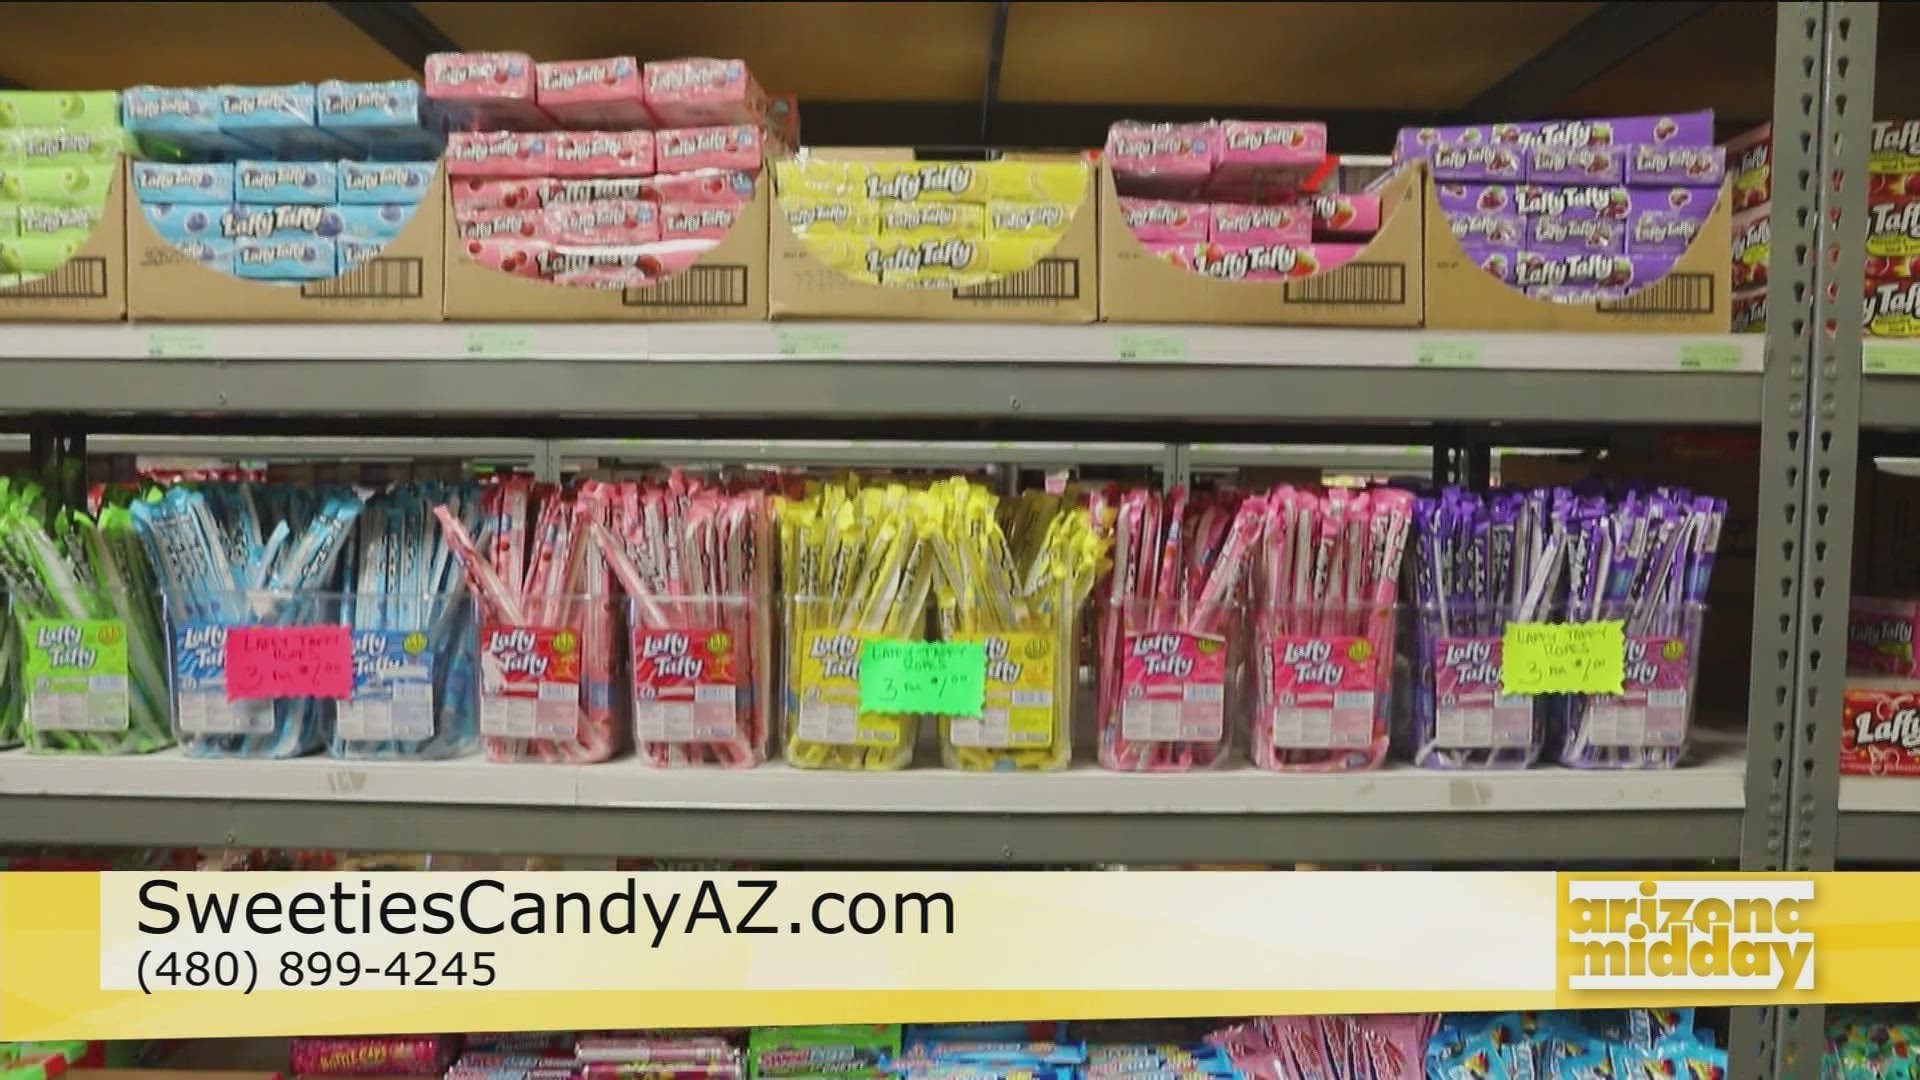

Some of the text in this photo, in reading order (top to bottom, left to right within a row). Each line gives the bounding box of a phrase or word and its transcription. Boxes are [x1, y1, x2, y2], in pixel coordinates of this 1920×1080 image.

[1229, 125, 1295, 150] Laffy Taffy
[1542, 121, 1591, 147] Taffy
[1872, 119, 1920, 155] Taff
[866, 164, 971, 201] Laffy Taffy
[1515, 185, 1610, 217] Laffy Taffy
[220, 205, 325, 238] Laffy Taffy
[1872, 202, 1920, 238] Taff
[866, 239, 972, 274] Laffy Taffy
[1194, 244, 1298, 280] Laffy Taffy
[1515, 253, 1614, 285] Laffy Taffy
[37, 624, 83, 648] Laffy
[184, 624, 227, 650] Laffy
[489, 630, 537, 653] Laffy
[643, 633, 690, 657] Laffy
[809, 635, 860, 658] Laffy
[1131, 635, 1181, 657] Laffy
[50, 648, 97, 670] Taffy
[1283, 639, 1331, 664] Laffy
[1444, 641, 1491, 667] Laffy
[500, 653, 548, 676] Taffy
[655, 655, 703, 680] Taffy
[822, 658, 861, 680] Taff
[1143, 655, 1193, 678] Taffy
[1295, 662, 1344, 686] Taffy
[1456, 663, 1503, 685] Taffy
[1518, 660, 1543, 686] 3
[879, 676, 898, 701] 3
